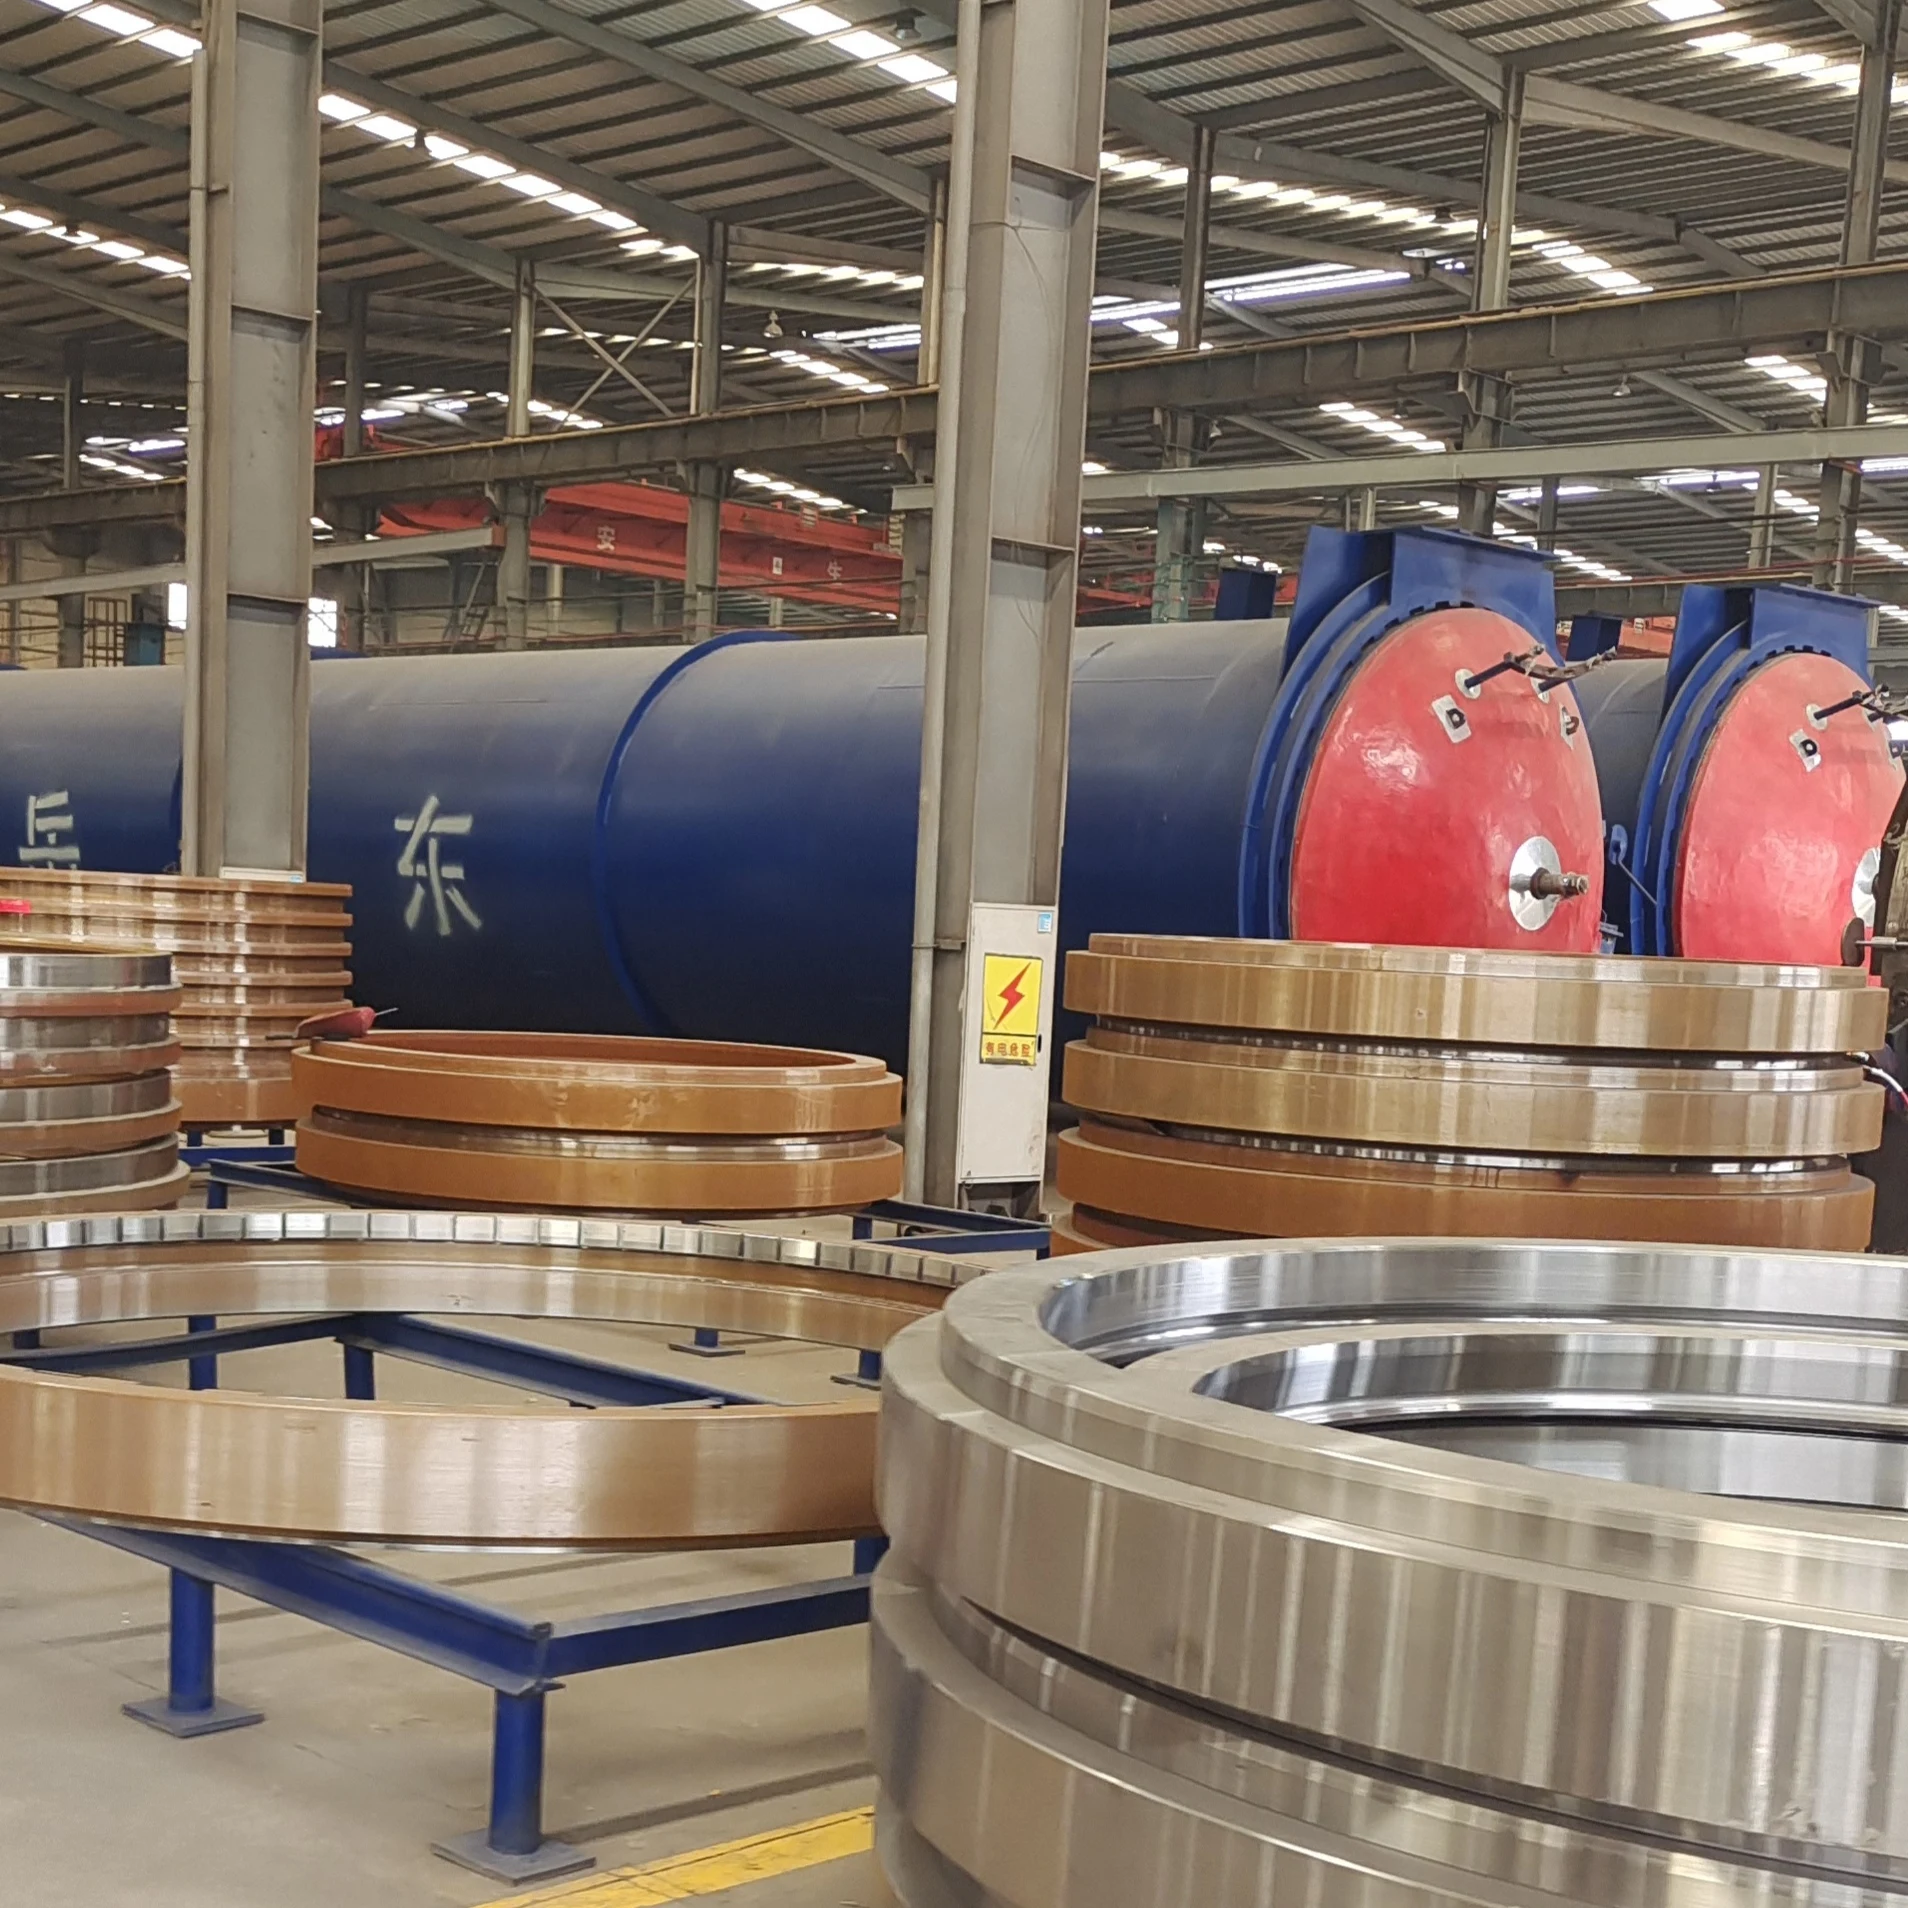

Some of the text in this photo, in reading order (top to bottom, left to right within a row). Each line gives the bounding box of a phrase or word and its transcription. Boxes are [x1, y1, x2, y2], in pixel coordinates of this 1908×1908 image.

[596, 525, 616, 551] 安
[394, 794, 483, 936] 东
[985, 1041, 1031, 1057] 有电危险
